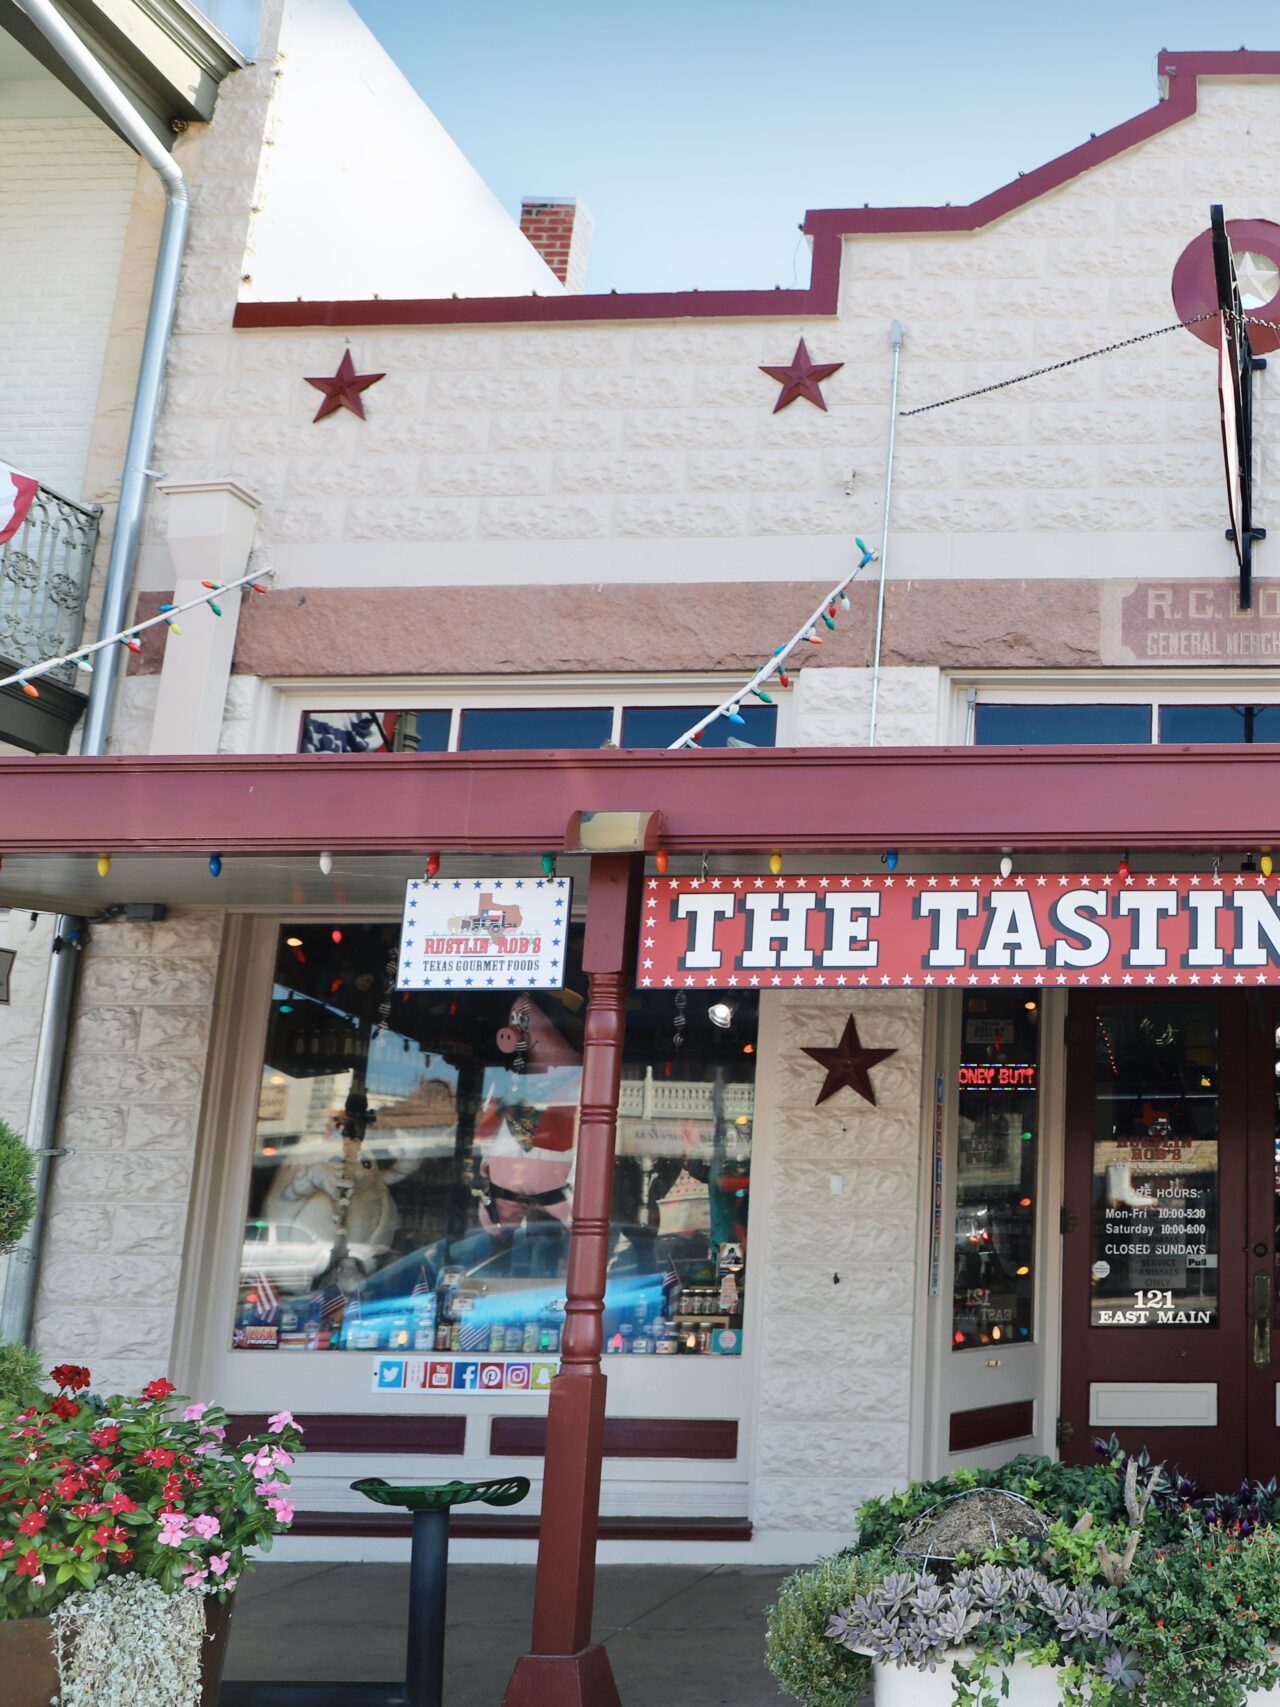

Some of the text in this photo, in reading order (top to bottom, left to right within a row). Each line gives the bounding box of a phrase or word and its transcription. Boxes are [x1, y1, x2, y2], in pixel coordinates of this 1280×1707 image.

[1147, 631, 1221, 656] GENERAL
[671, 890, 880, 970] THE
[497, 936, 542, 954] ROB'S
[423, 959, 540, 972] TEXAS GOURMET FOODS
[1157, 1189, 1201, 1198] HOURS:
[1105, 1208, 1206, 1219] Mon-Fri 10:00-5:30
[1105, 1223, 1206, 1236] Saturday 10:00-6:00
[1105, 1244, 1206, 1255] CLOSED SUNDAYS
[1188, 1258, 1207, 1266] Pull
[1134, 1289, 1175, 1308] 121
[1098, 1311, 1211, 1324] EAST MAIN
